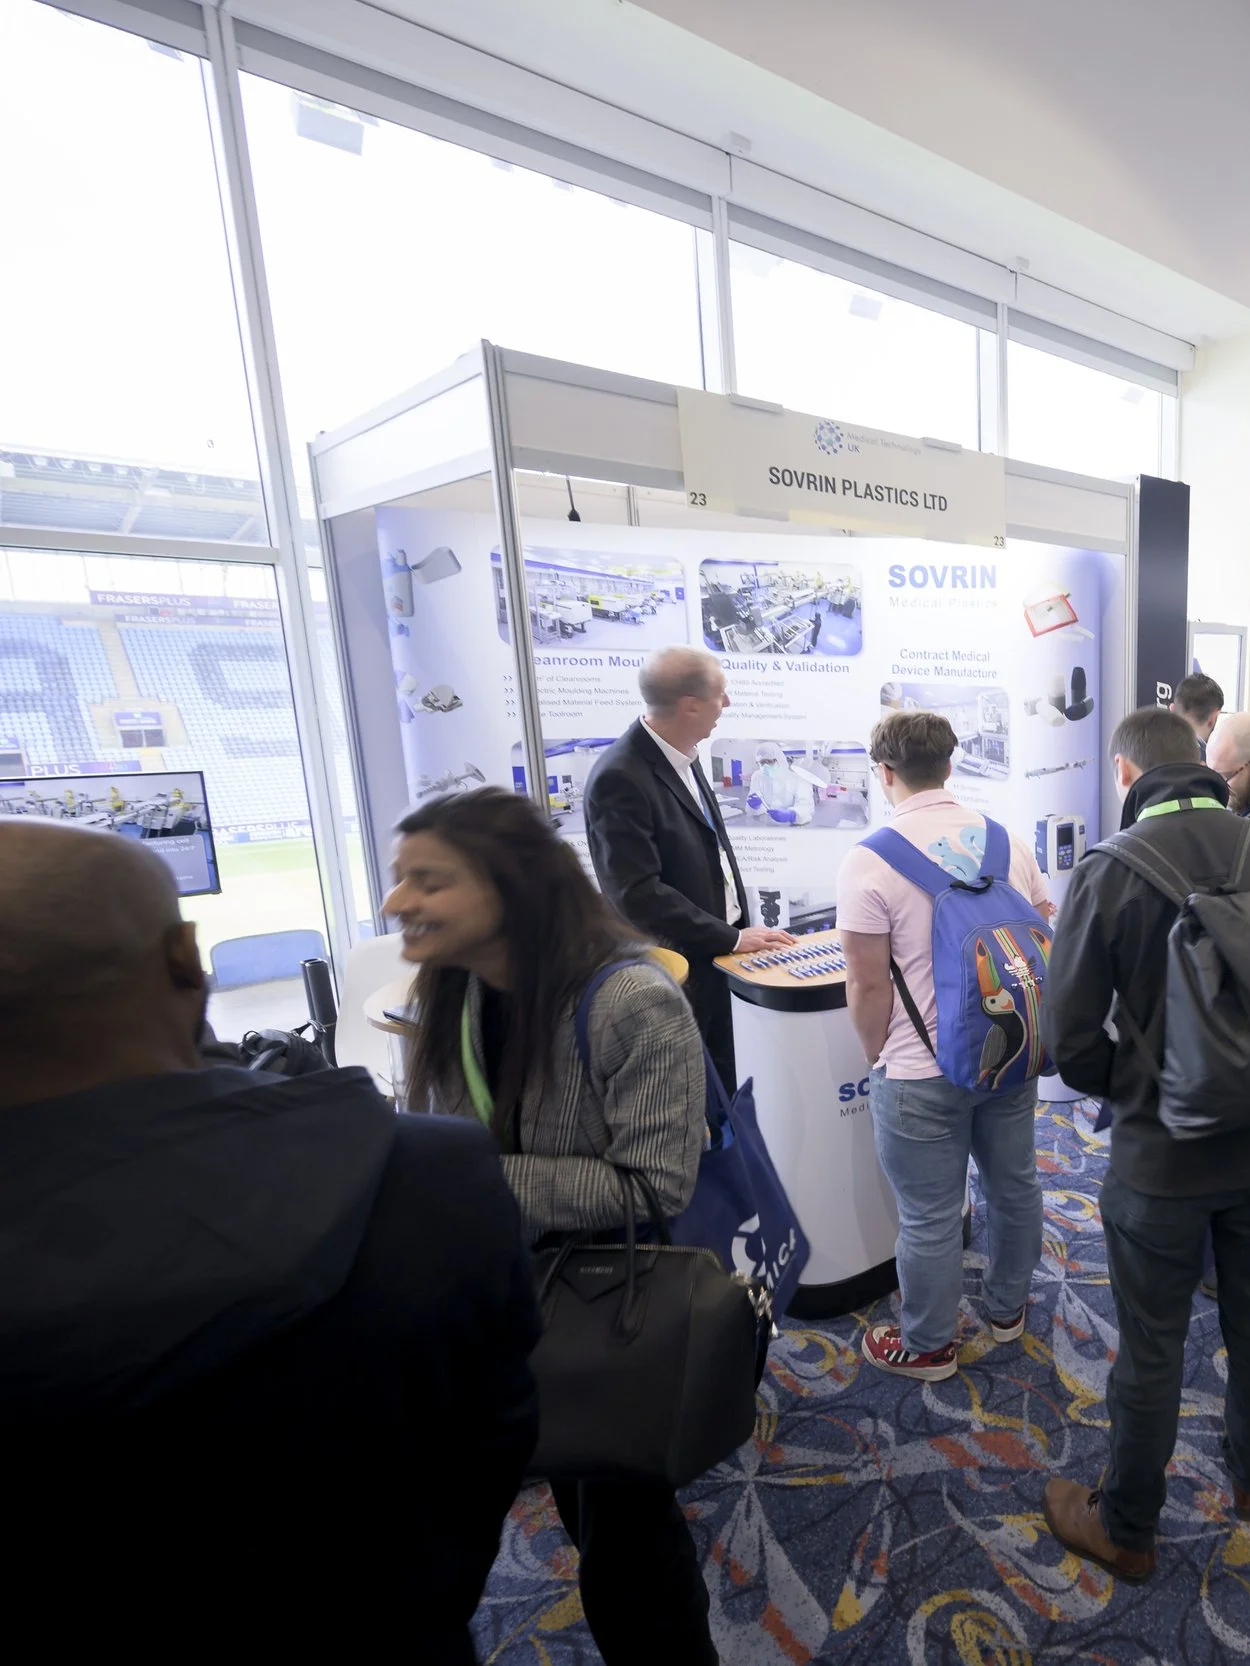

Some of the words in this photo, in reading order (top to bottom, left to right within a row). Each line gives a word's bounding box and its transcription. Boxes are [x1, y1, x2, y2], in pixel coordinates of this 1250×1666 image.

[847, 444, 861, 455] UK
[768, 465, 837, 496] SOVRIN
[842, 478, 919, 508] PLASTICS
[923, 492, 948, 512] LTD
[689, 491, 708, 507] 23
[993, 535, 1005, 548] 23
[887, 564, 997, 590] SOVRIN
[889, 596, 943, 610] Medical
[899, 648, 950, 662] Contract
[952, 650, 991, 663] Medical
[721, 658, 768, 673] Quality
[772, 660, 782, 672] &
[785, 660, 850, 674] Validation
[892, 664, 931, 676] Device
[932, 666, 998, 679] Manufacture
